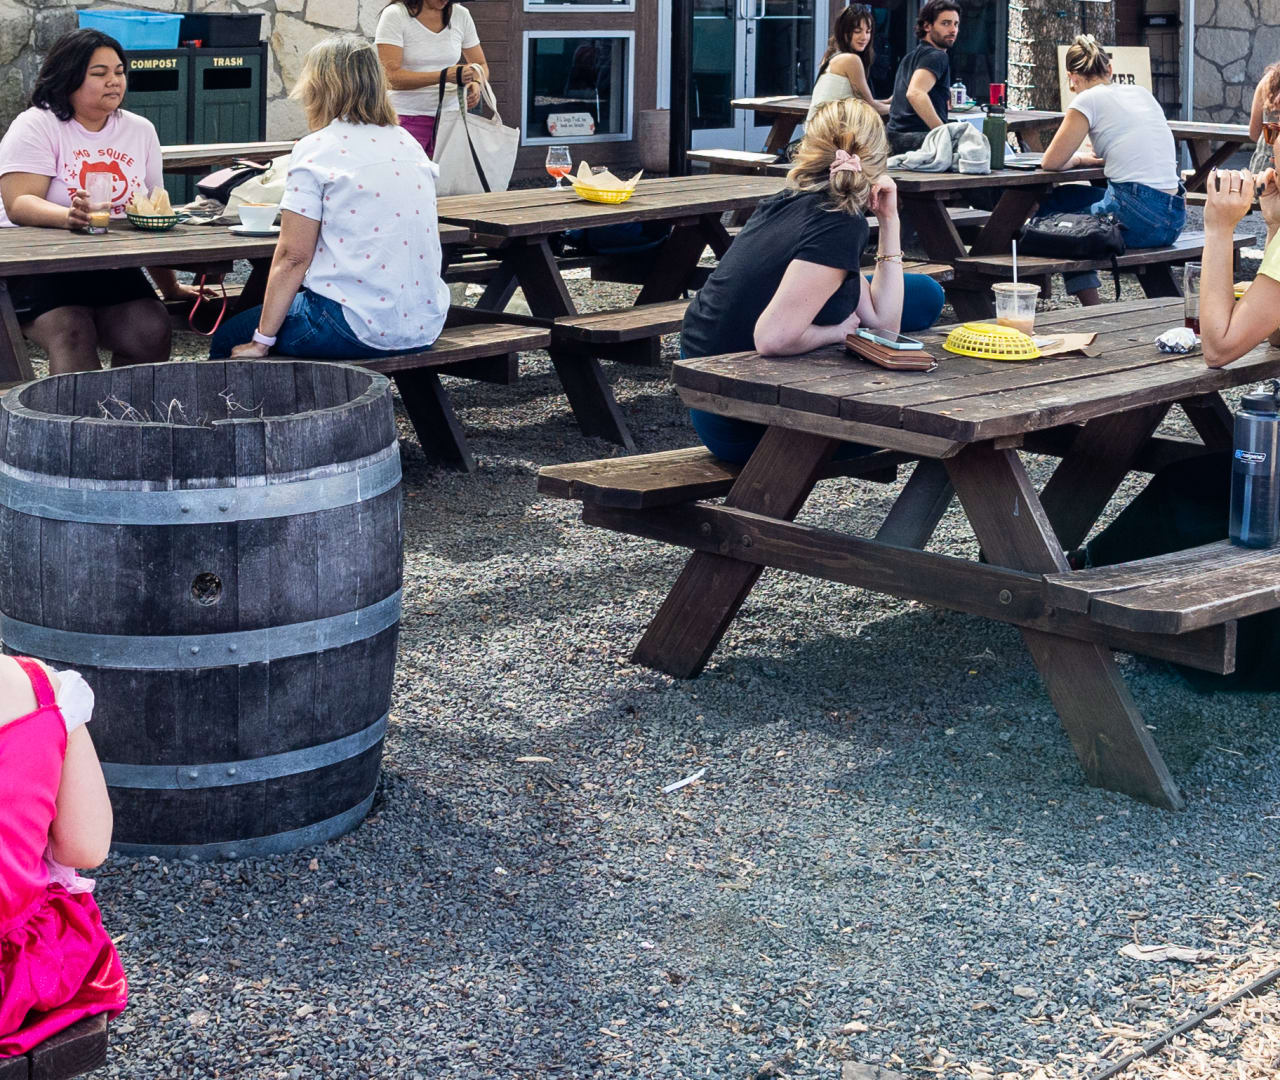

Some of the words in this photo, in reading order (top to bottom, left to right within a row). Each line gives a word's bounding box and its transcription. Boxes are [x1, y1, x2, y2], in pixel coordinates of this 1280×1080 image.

[131, 59, 177, 69] COMPOST
[213, 57, 243, 66] TRASH
[97, 148, 135, 167] SQUEE
